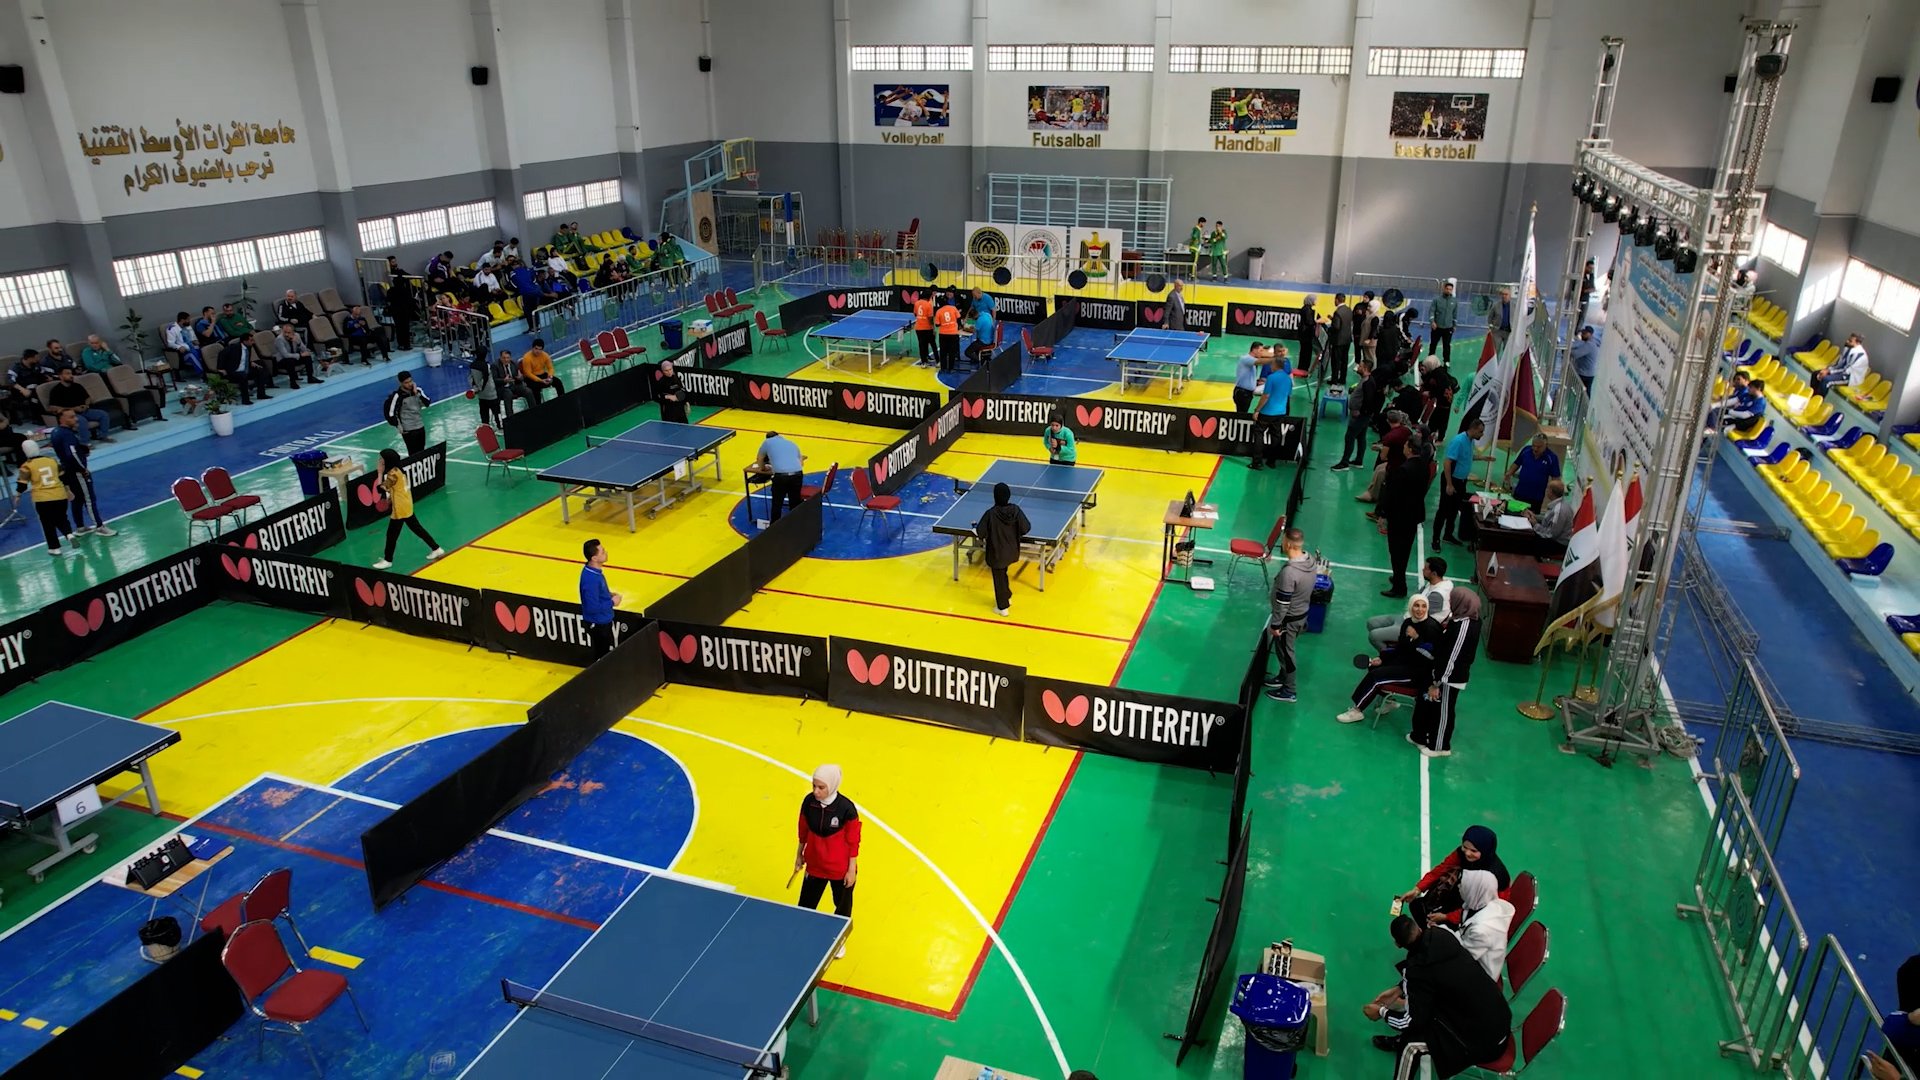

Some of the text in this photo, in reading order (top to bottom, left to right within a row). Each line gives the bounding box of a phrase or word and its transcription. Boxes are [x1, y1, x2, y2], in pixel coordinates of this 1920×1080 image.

[140, 118, 200, 160] الأوسط
[203, 121, 250, 154] الفرات
[251, 119, 295, 144] جامعة
[882, 132, 944, 145] Volleyball
[1033, 132, 1101, 148] Futsalball
[1215, 135, 1281, 152] Handball
[1395, 141, 1476, 159] basketball
[124, 162, 169, 196] الكرام
[38, 465, 56, 486] 2
[76, 801, 87, 815] 6
